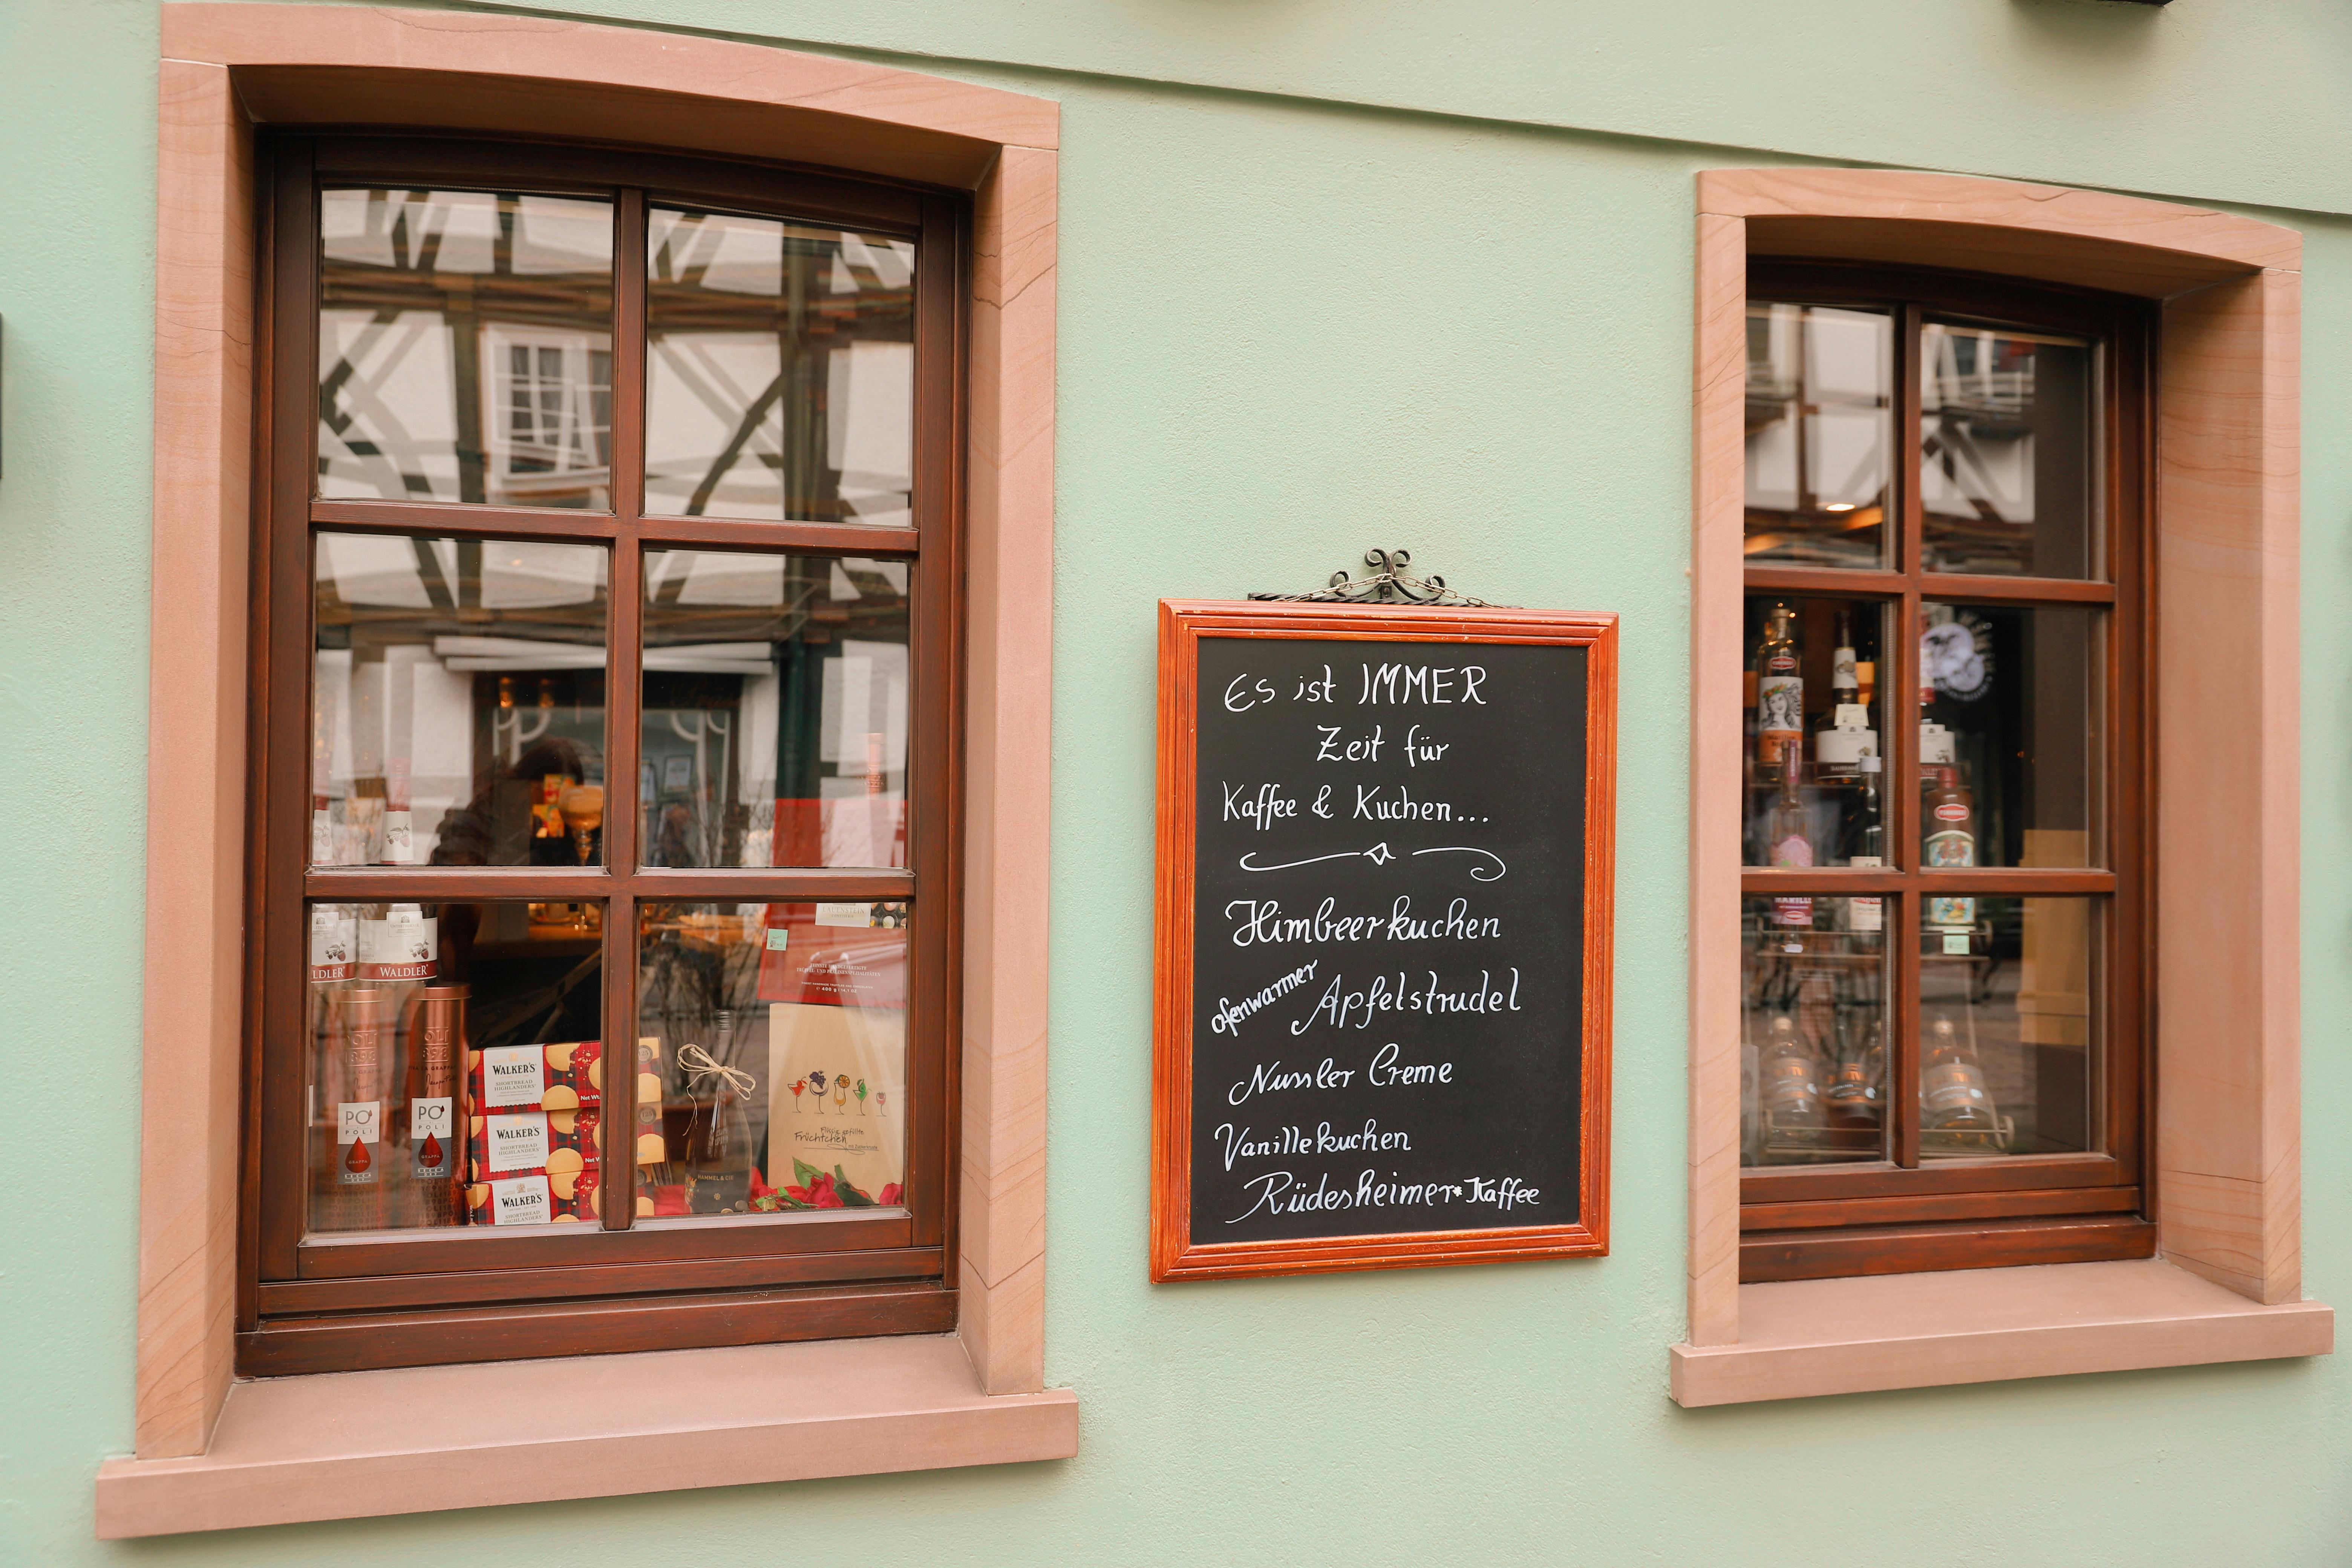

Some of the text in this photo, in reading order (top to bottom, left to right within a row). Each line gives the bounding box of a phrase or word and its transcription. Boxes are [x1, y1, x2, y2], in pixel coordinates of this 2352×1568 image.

[1224, 662, 1487, 712] Es ist IMMER
[1316, 724, 1450, 767] Zeit für
[1222, 780, 1298, 831] Kaffee
[1311, 784, 1334, 819] &
[1225, 895, 1501, 947] Himbeerkuchen
[1211, 959, 1318, 1037] ofenwarmer
[1291, 967, 1521, 1035] Apfelstrudel
[492, 1062, 536, 1075] WALKER'S
[1369, 1043, 1453, 1086] Creme
[496, 1126, 540, 1139] WALKER'S
[794, 1131, 846, 1143] Früchtchen
[1214, 1118, 1411, 1172] Vanillekuchen
[501, 1193, 542, 1208] WALKER'S
[505, 1210, 540, 1219] SHORTBREAD
